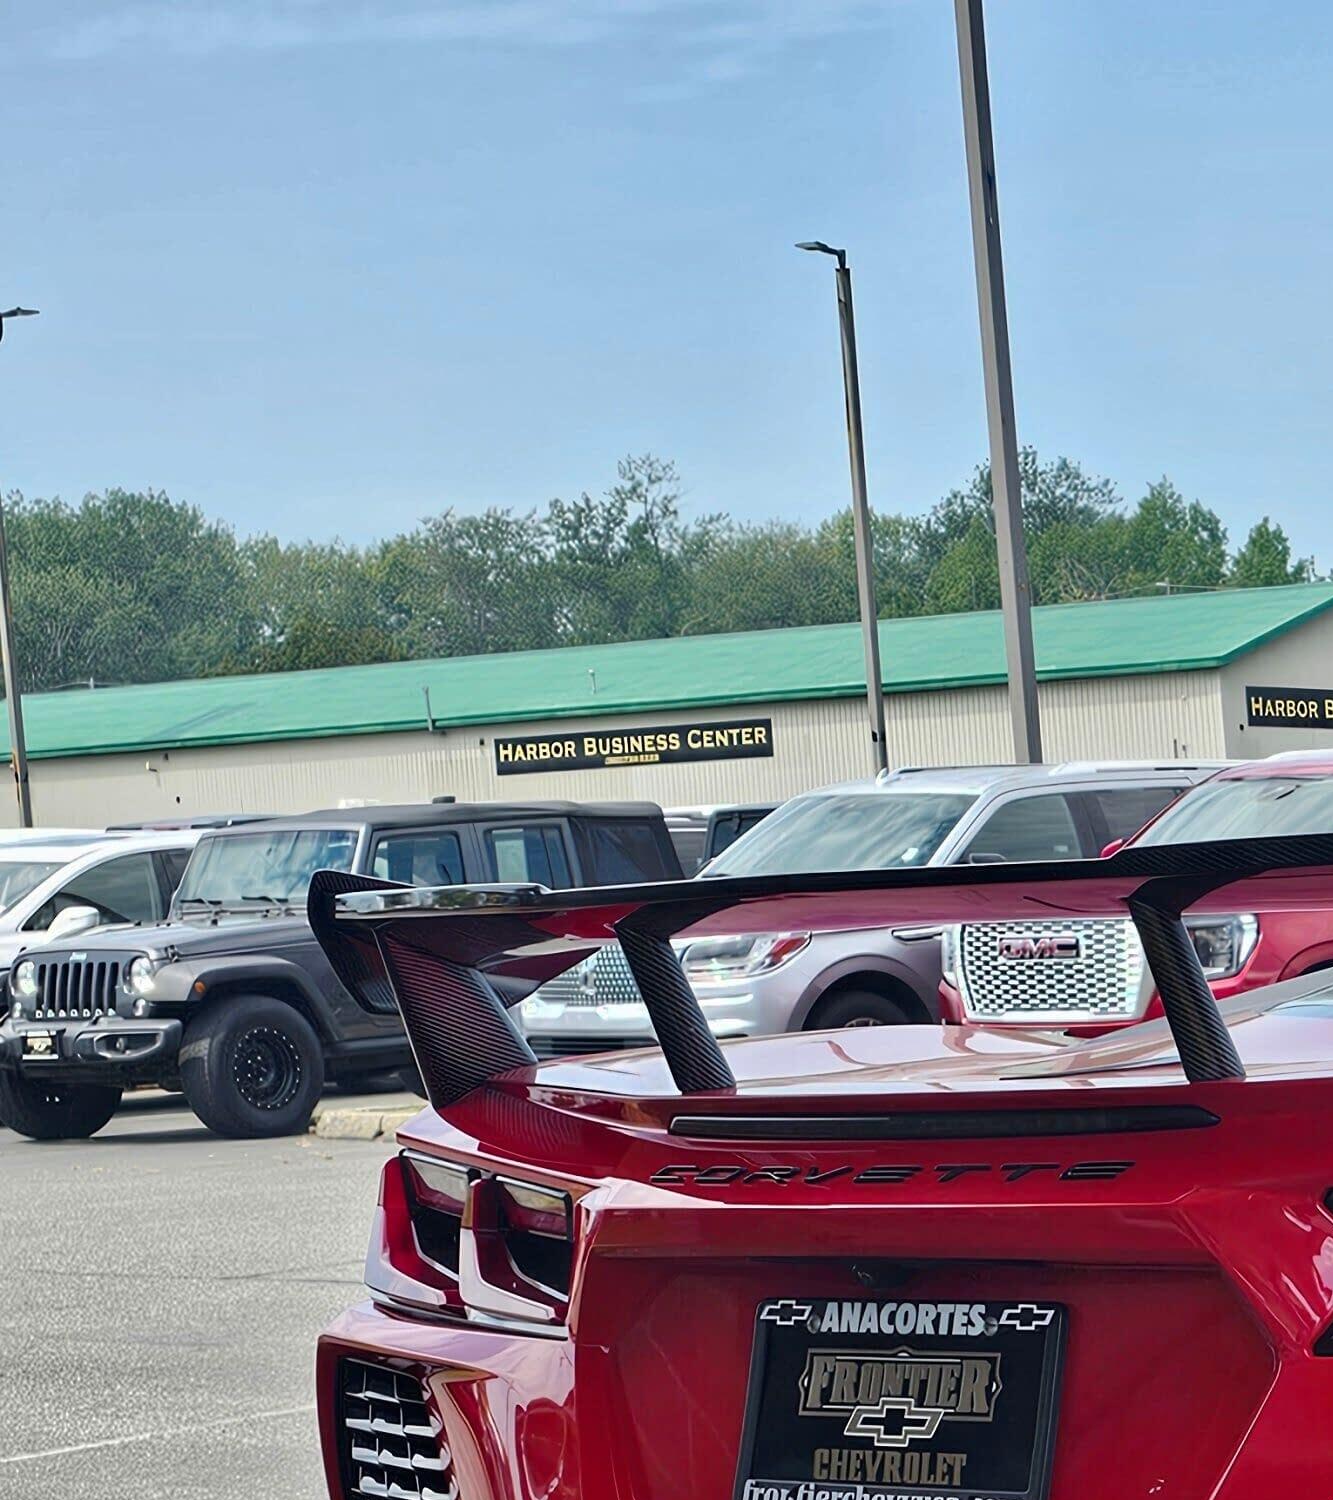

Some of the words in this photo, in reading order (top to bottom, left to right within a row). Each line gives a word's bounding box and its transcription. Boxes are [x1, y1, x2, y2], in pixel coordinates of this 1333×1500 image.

[1251, 697, 1318, 718] HARBOR
[499, 741, 576, 762] HARBOR
[584, 733, 681, 757] BUSINESS
[687, 726, 767, 750] CENTER
[1000, 938, 1078, 960] GMC
[650, 1160, 1136, 1187] CORVETTE
[820, 1302, 987, 1336] ANACORTES
[806, 1355, 993, 1414] FRONTIER
[812, 1448, 967, 1486] CHEVROLET
